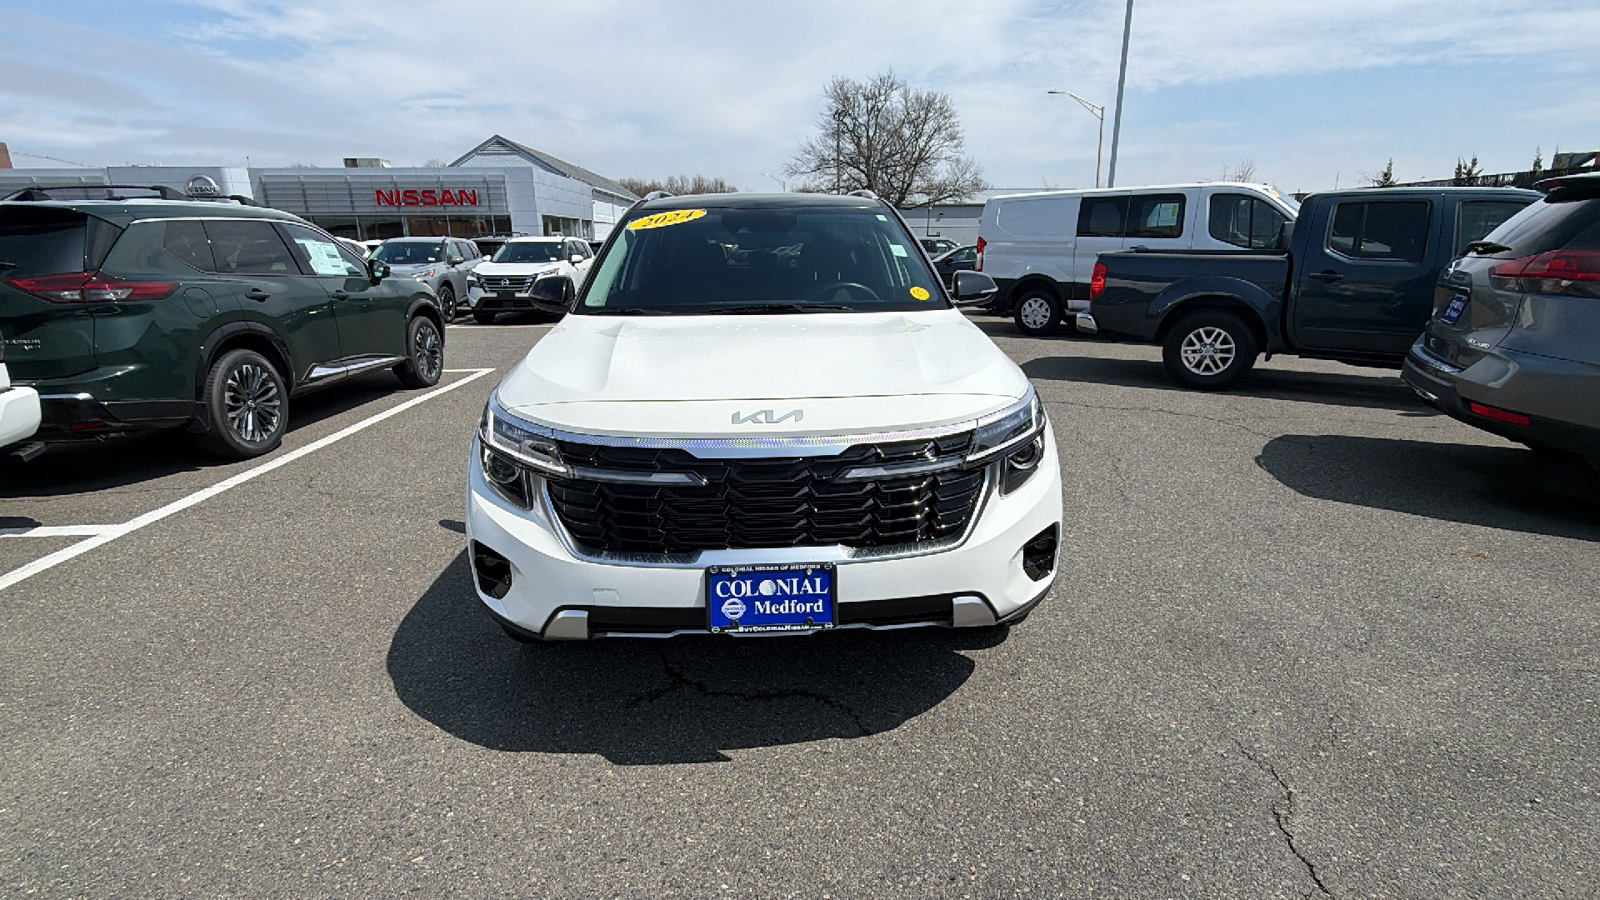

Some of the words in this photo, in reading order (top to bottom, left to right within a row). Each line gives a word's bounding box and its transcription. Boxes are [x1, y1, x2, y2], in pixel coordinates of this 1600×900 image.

[375, 189, 478, 206] NISSAN
[641, 210, 696, 227] 2024
[731, 410, 803, 424] KIA
[716, 577, 829, 597] COLONIAL
[754, 599, 824, 614] Medford
